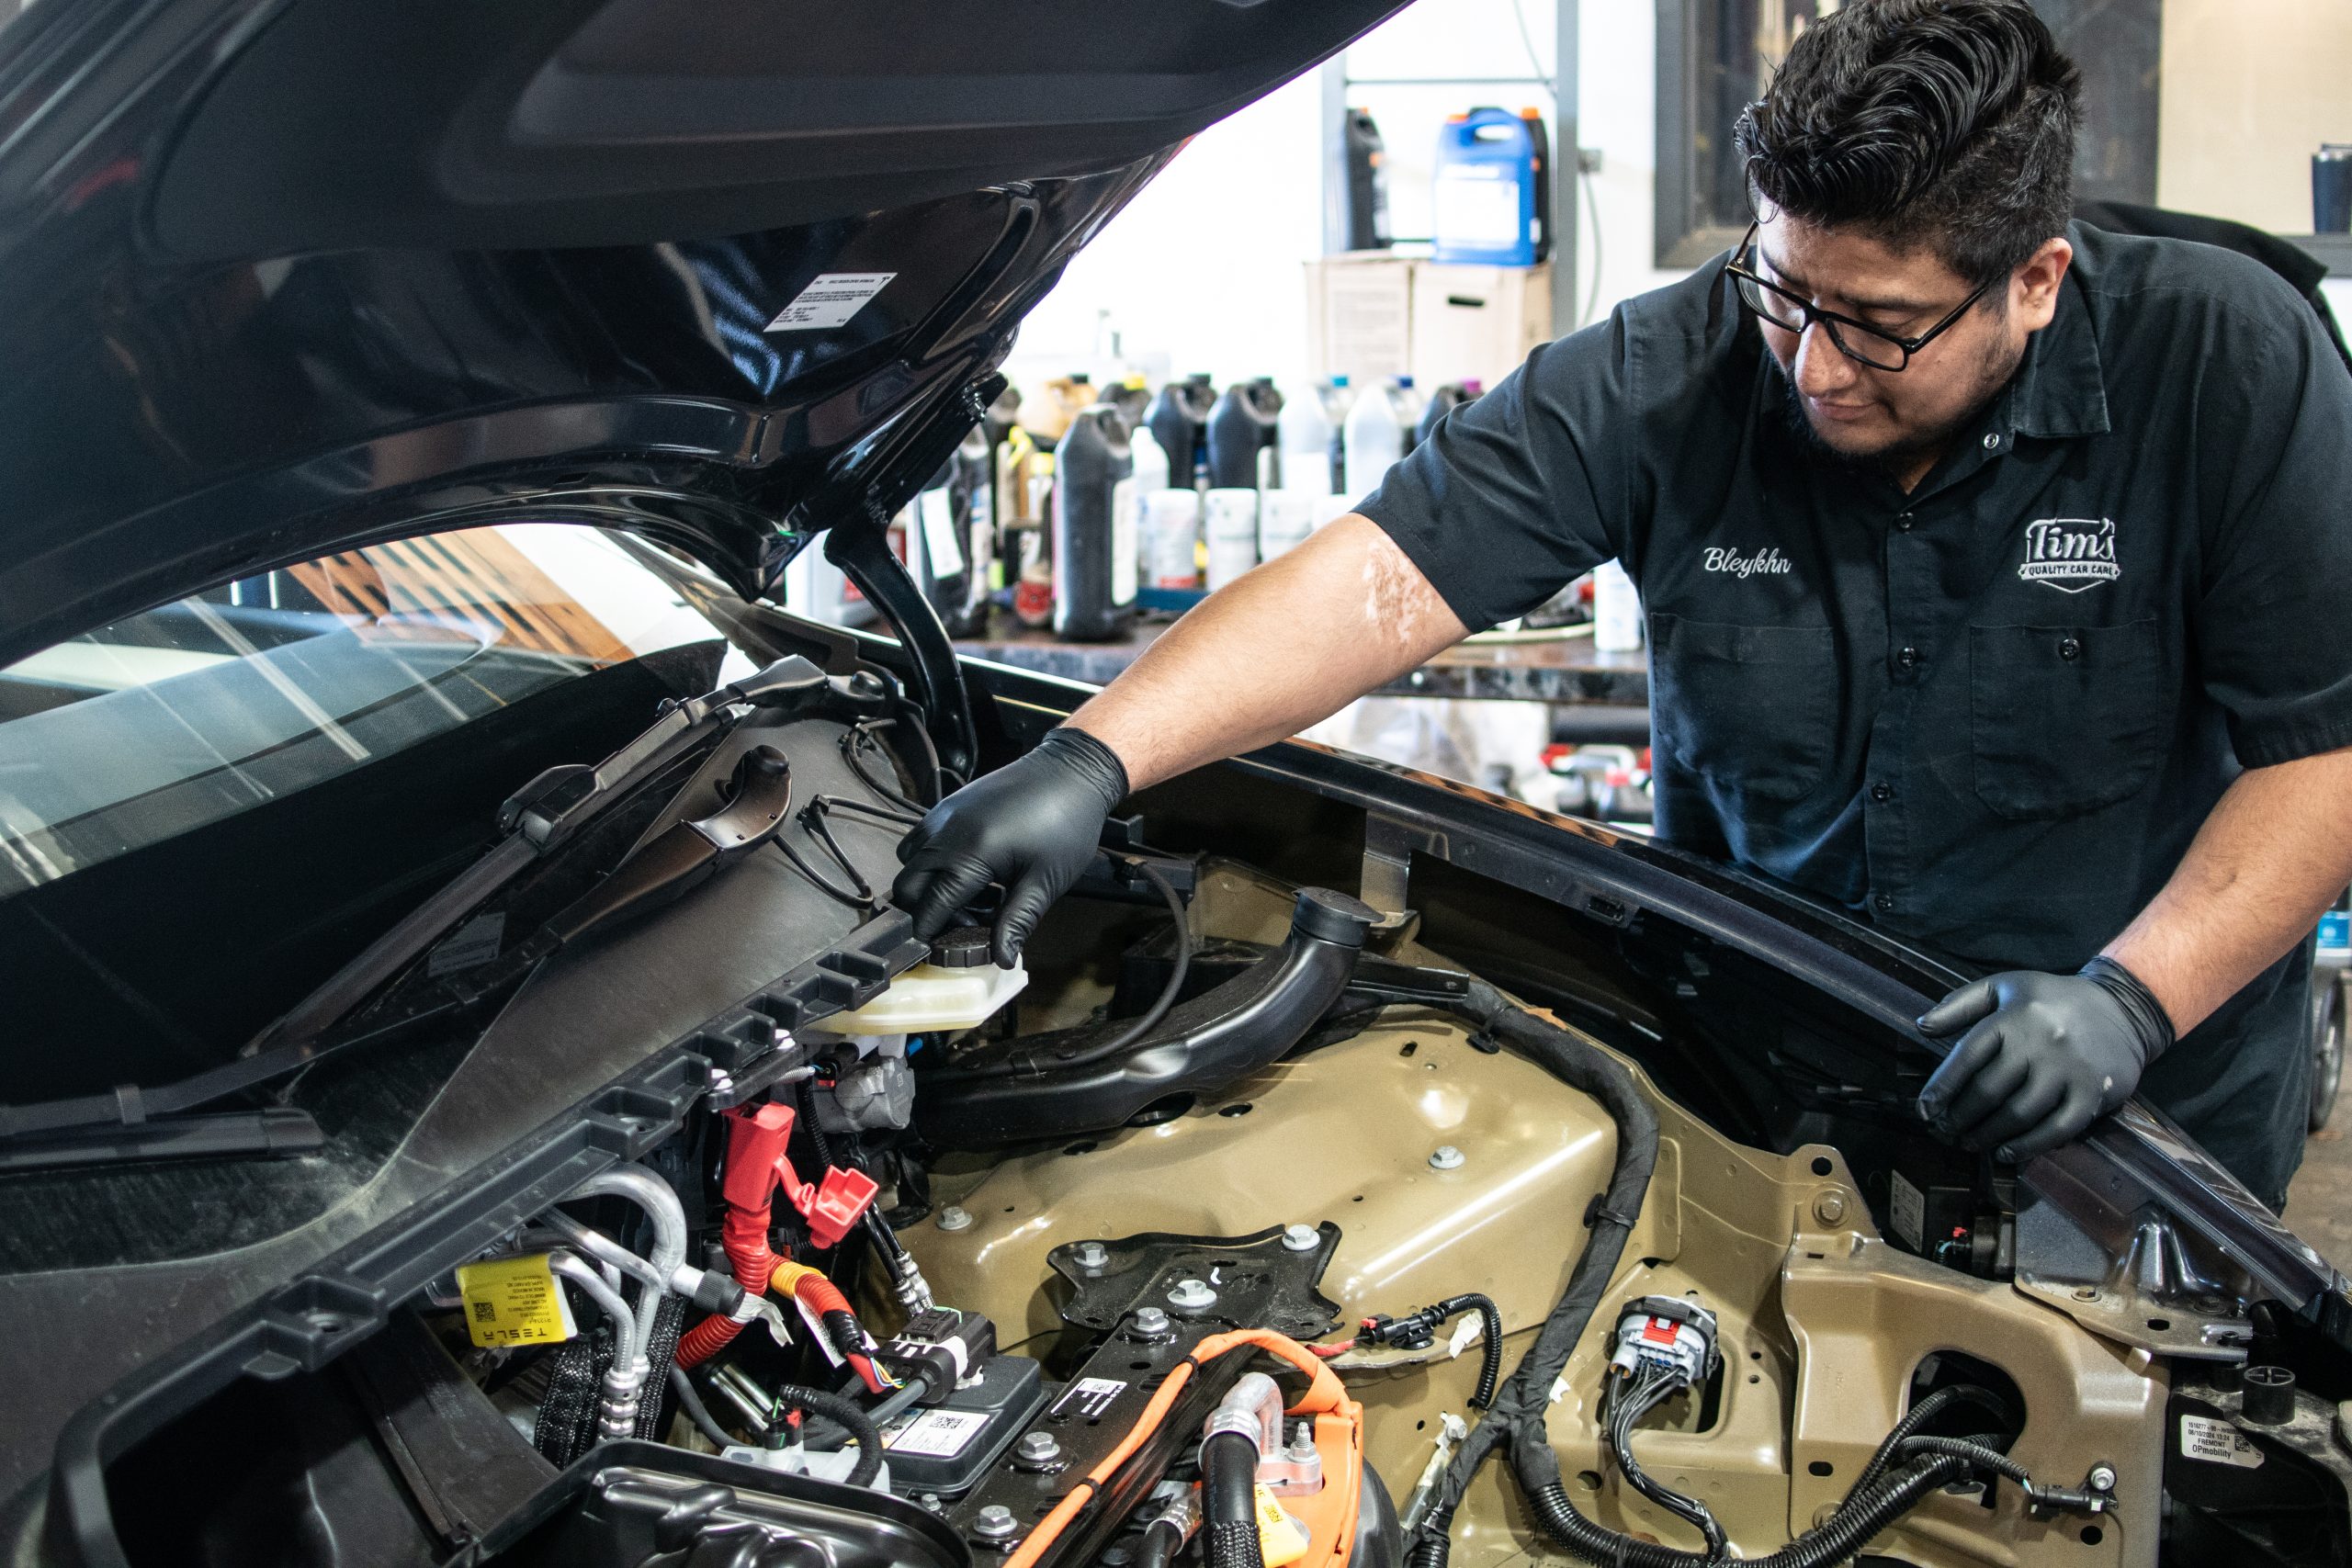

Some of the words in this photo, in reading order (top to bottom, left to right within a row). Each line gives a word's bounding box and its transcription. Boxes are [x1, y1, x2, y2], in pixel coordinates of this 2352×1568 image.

[2025, 517, 2115, 559] Tim's
[1703, 547, 1792, 579] Bleykhn
[2029, 566, 2067, 576] QUALITY
[2070, 566, 2088, 574] CAR
[2091, 566, 2112, 575] CARE
[483, 1327, 548, 1340] TESLA
[2198, 1438, 2226, 1449] FREMONT
[2192, 1444, 2231, 1459] OPmobility
